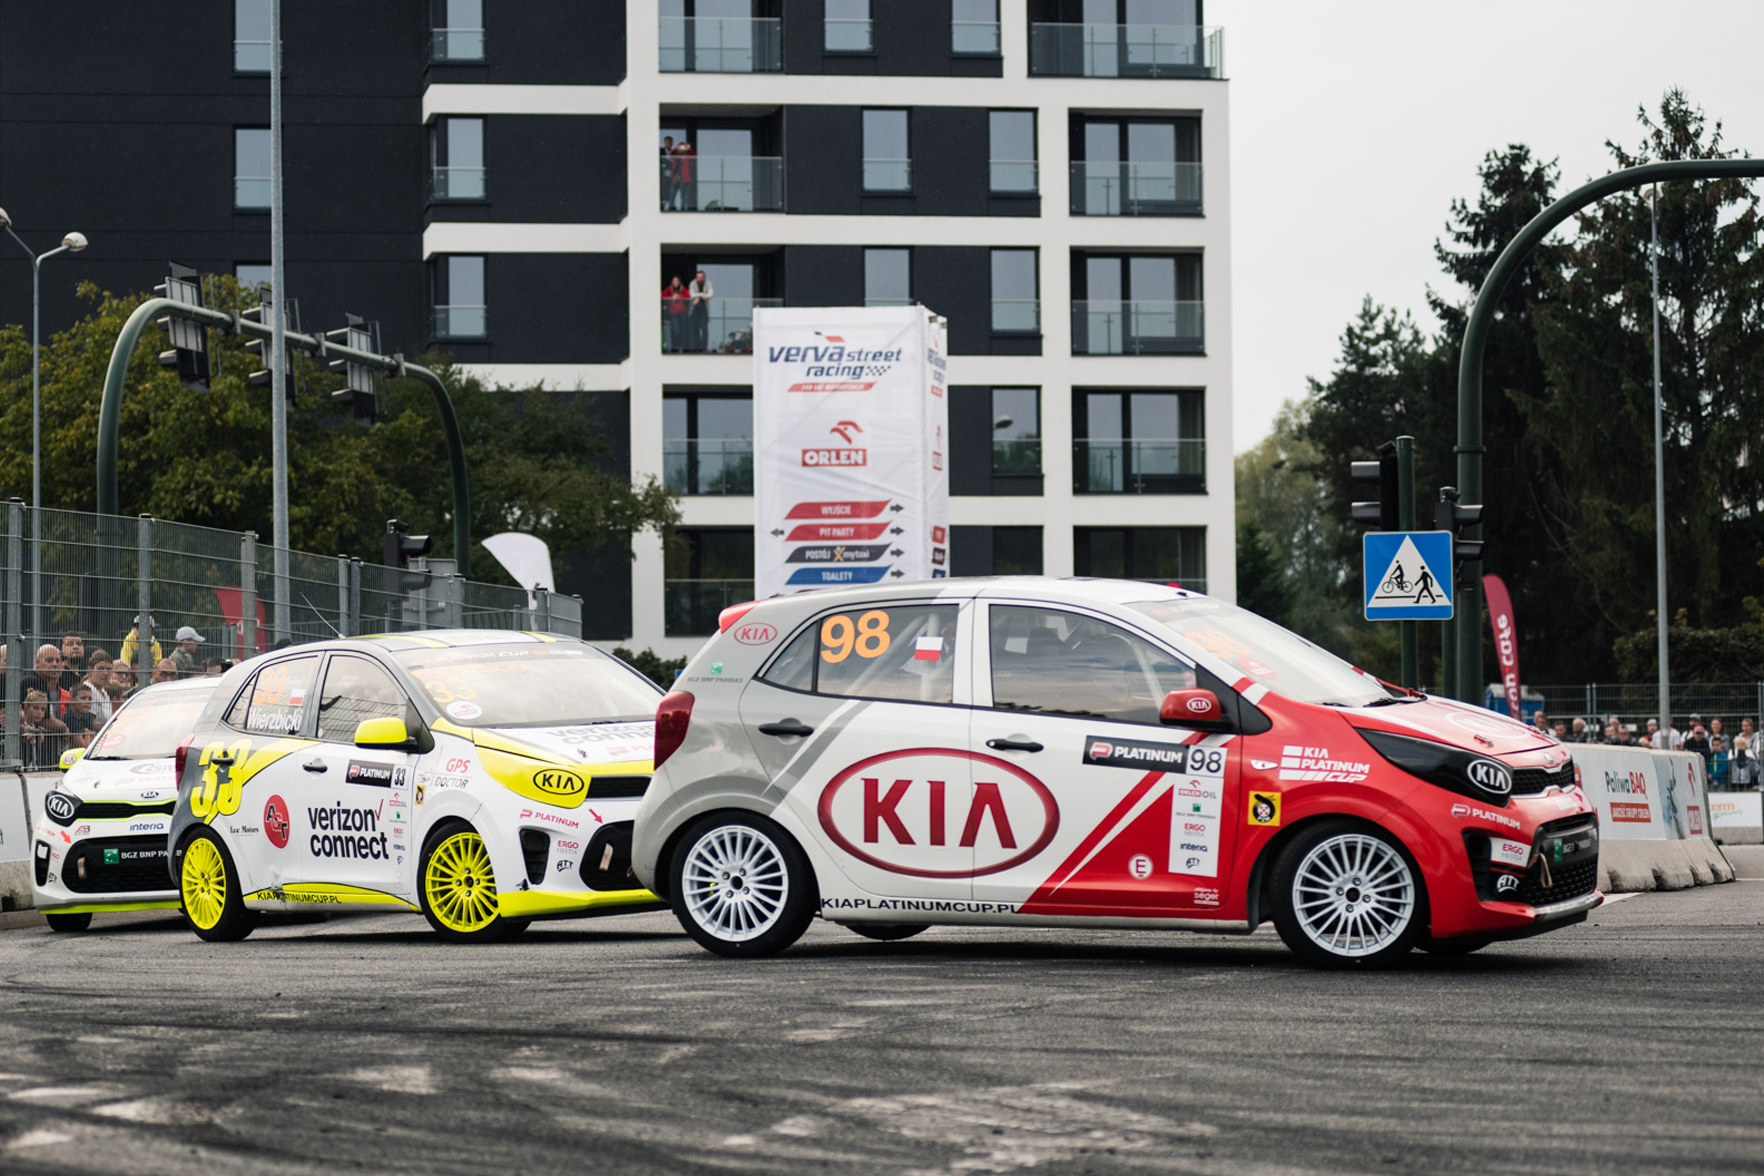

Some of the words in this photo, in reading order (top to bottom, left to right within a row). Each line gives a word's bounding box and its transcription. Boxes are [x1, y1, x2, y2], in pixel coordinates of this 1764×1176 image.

[769, 346, 845, 362] verva
[846, 347, 902, 362] street
[806, 363, 864, 379] racing
[804, 451, 863, 465] ORLEN
[819, 527, 831, 537] PIT
[832, 527, 855, 537] PARTY
[843, 550, 870, 560] mytaxi
[821, 571, 853, 581] TOALETY
[741, 628, 770, 640] KIA
[820, 609, 891, 664] 98
[254, 666, 288, 706] 33
[425, 679, 477, 704] 33
[1190, 700, 1209, 710] KIA
[247, 708, 303, 731] Wierzbicki
[1114, 745, 1183, 763] PLATINUM
[1303, 747, 1329, 758] KIA
[446, 758, 471, 773] GPS
[1190, 748, 1222, 774] 98
[1301, 759, 1370, 773] PLATINUM
[190, 738, 252, 818] 33
[359, 766, 391, 780] PLATINUM
[394, 767, 406, 786] 33
[1325, 771, 1368, 783] CUP
[1475, 764, 1507, 790] KIA
[435, 776, 468, 788] DOCTOR
[541, 773, 575, 791] KIA
[1202, 790, 1217, 799] OIL
[50, 798, 68, 816] KIA
[860, 777, 1018, 849] KIA
[308, 800, 377, 832] verizon
[535, 812, 579, 828] PLATINUM
[1472, 807, 1521, 830] PLATINUM
[129, 822, 164, 832] interia
[1184, 823, 1206, 832] ERGO
[310, 832, 389, 859] connect
[557, 840, 579, 849] ERGO
[1180, 842, 1208, 852] interia
[1502, 843, 1524, 855] ERGO
[139, 850, 157, 858] BNP
[1136, 859, 1147, 874] E
[1497, 874, 1520, 892] ATT
[821, 898, 1020, 914] KIAPLATINUMCUP.PL
